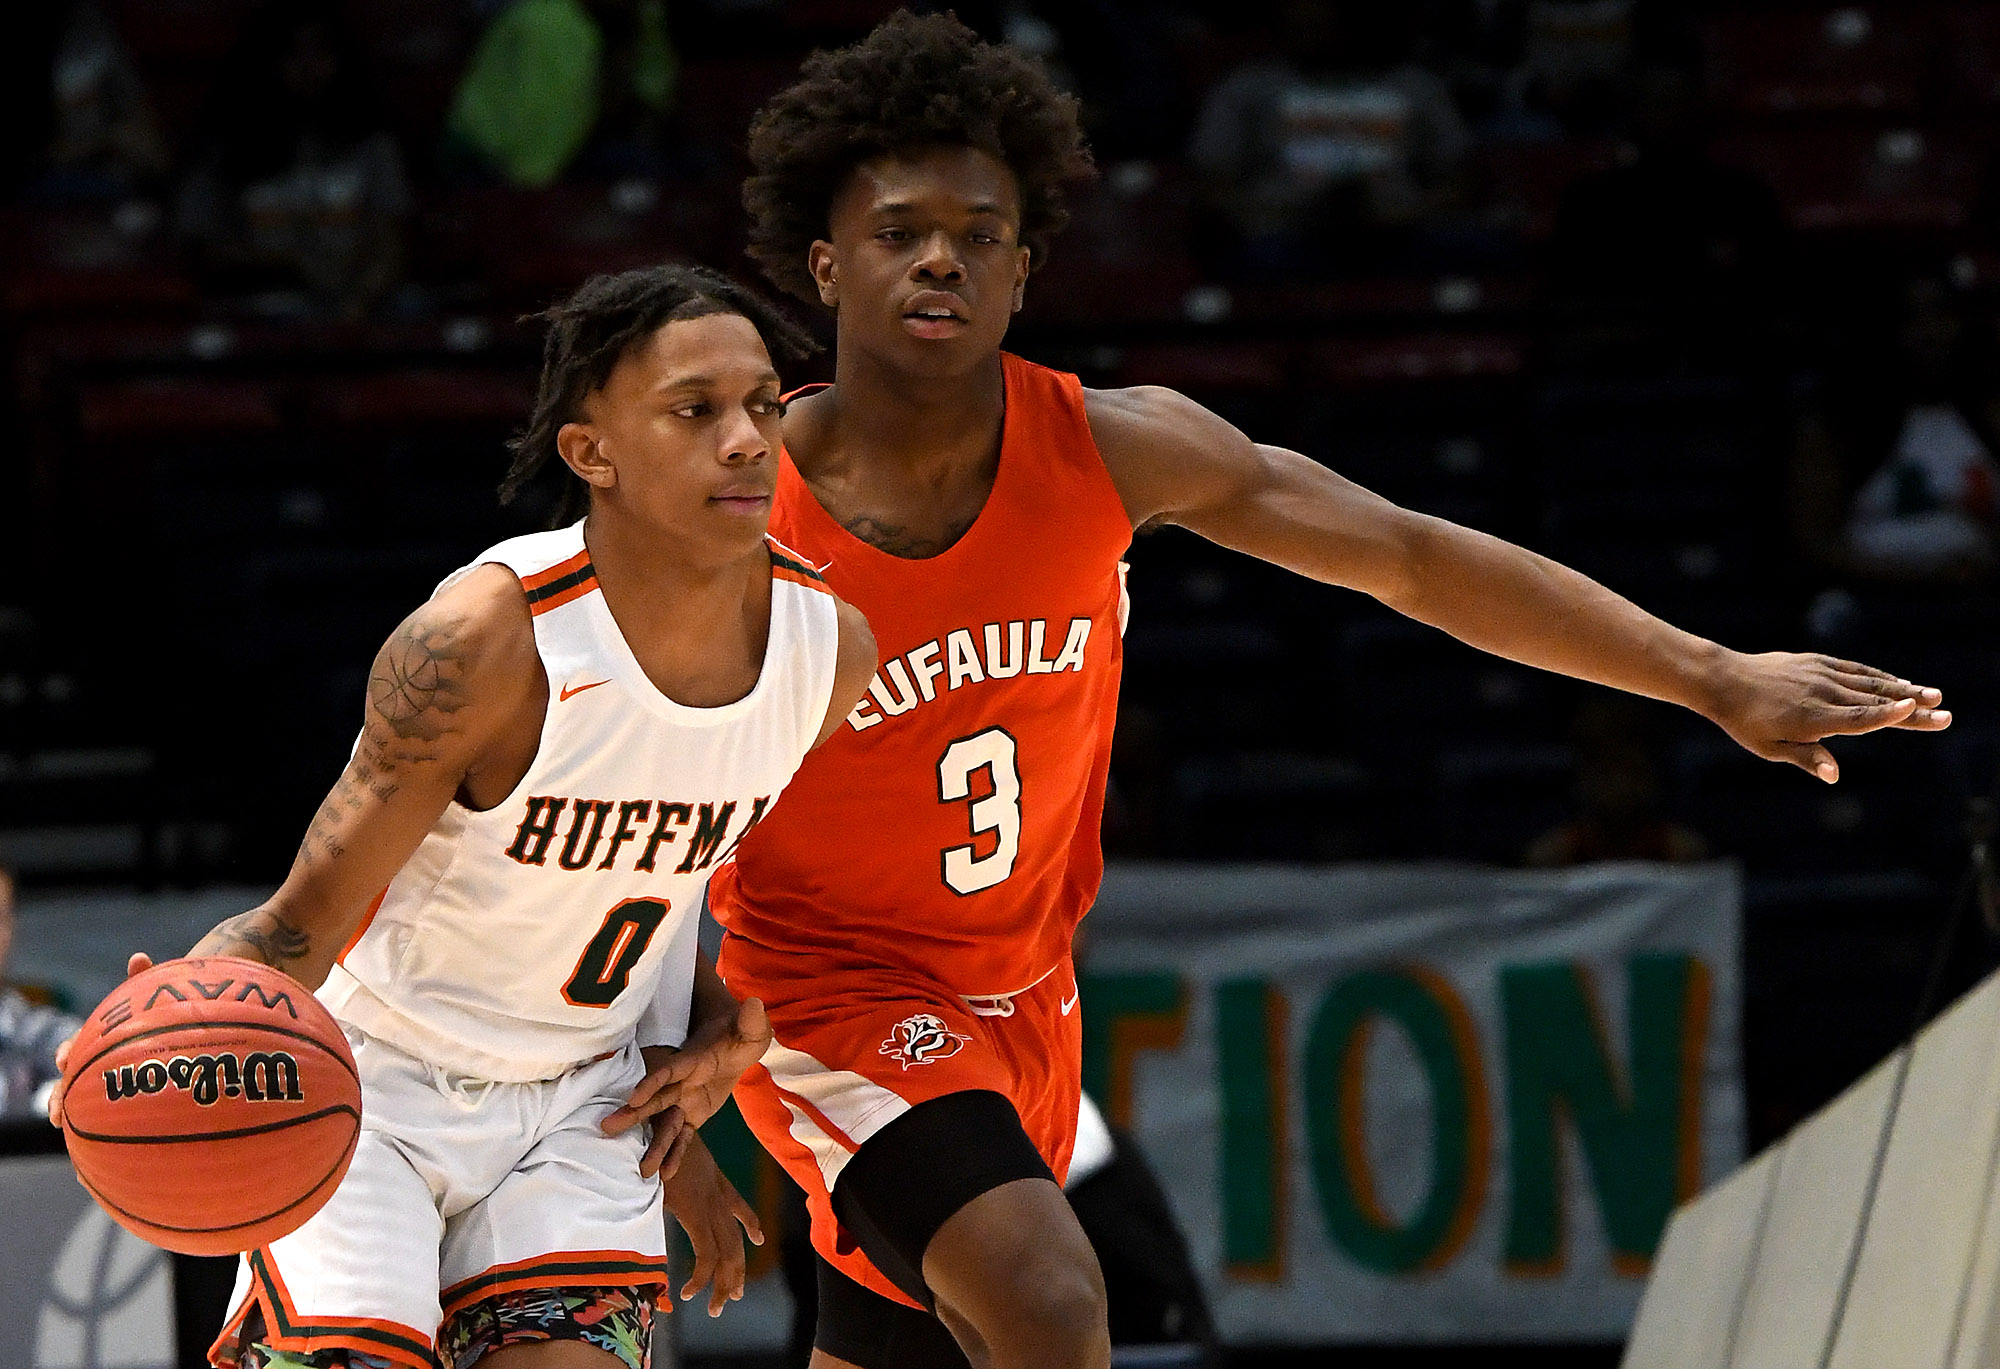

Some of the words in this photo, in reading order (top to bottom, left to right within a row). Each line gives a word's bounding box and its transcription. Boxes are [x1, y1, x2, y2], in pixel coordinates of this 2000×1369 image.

[846, 617, 1092, 732] EUFAULA
[936, 725, 1022, 897] 3
[100, 978, 298, 1038] WAVE
[560, 896, 671, 1009] 0
[102, 1051, 304, 1107] Wilson
